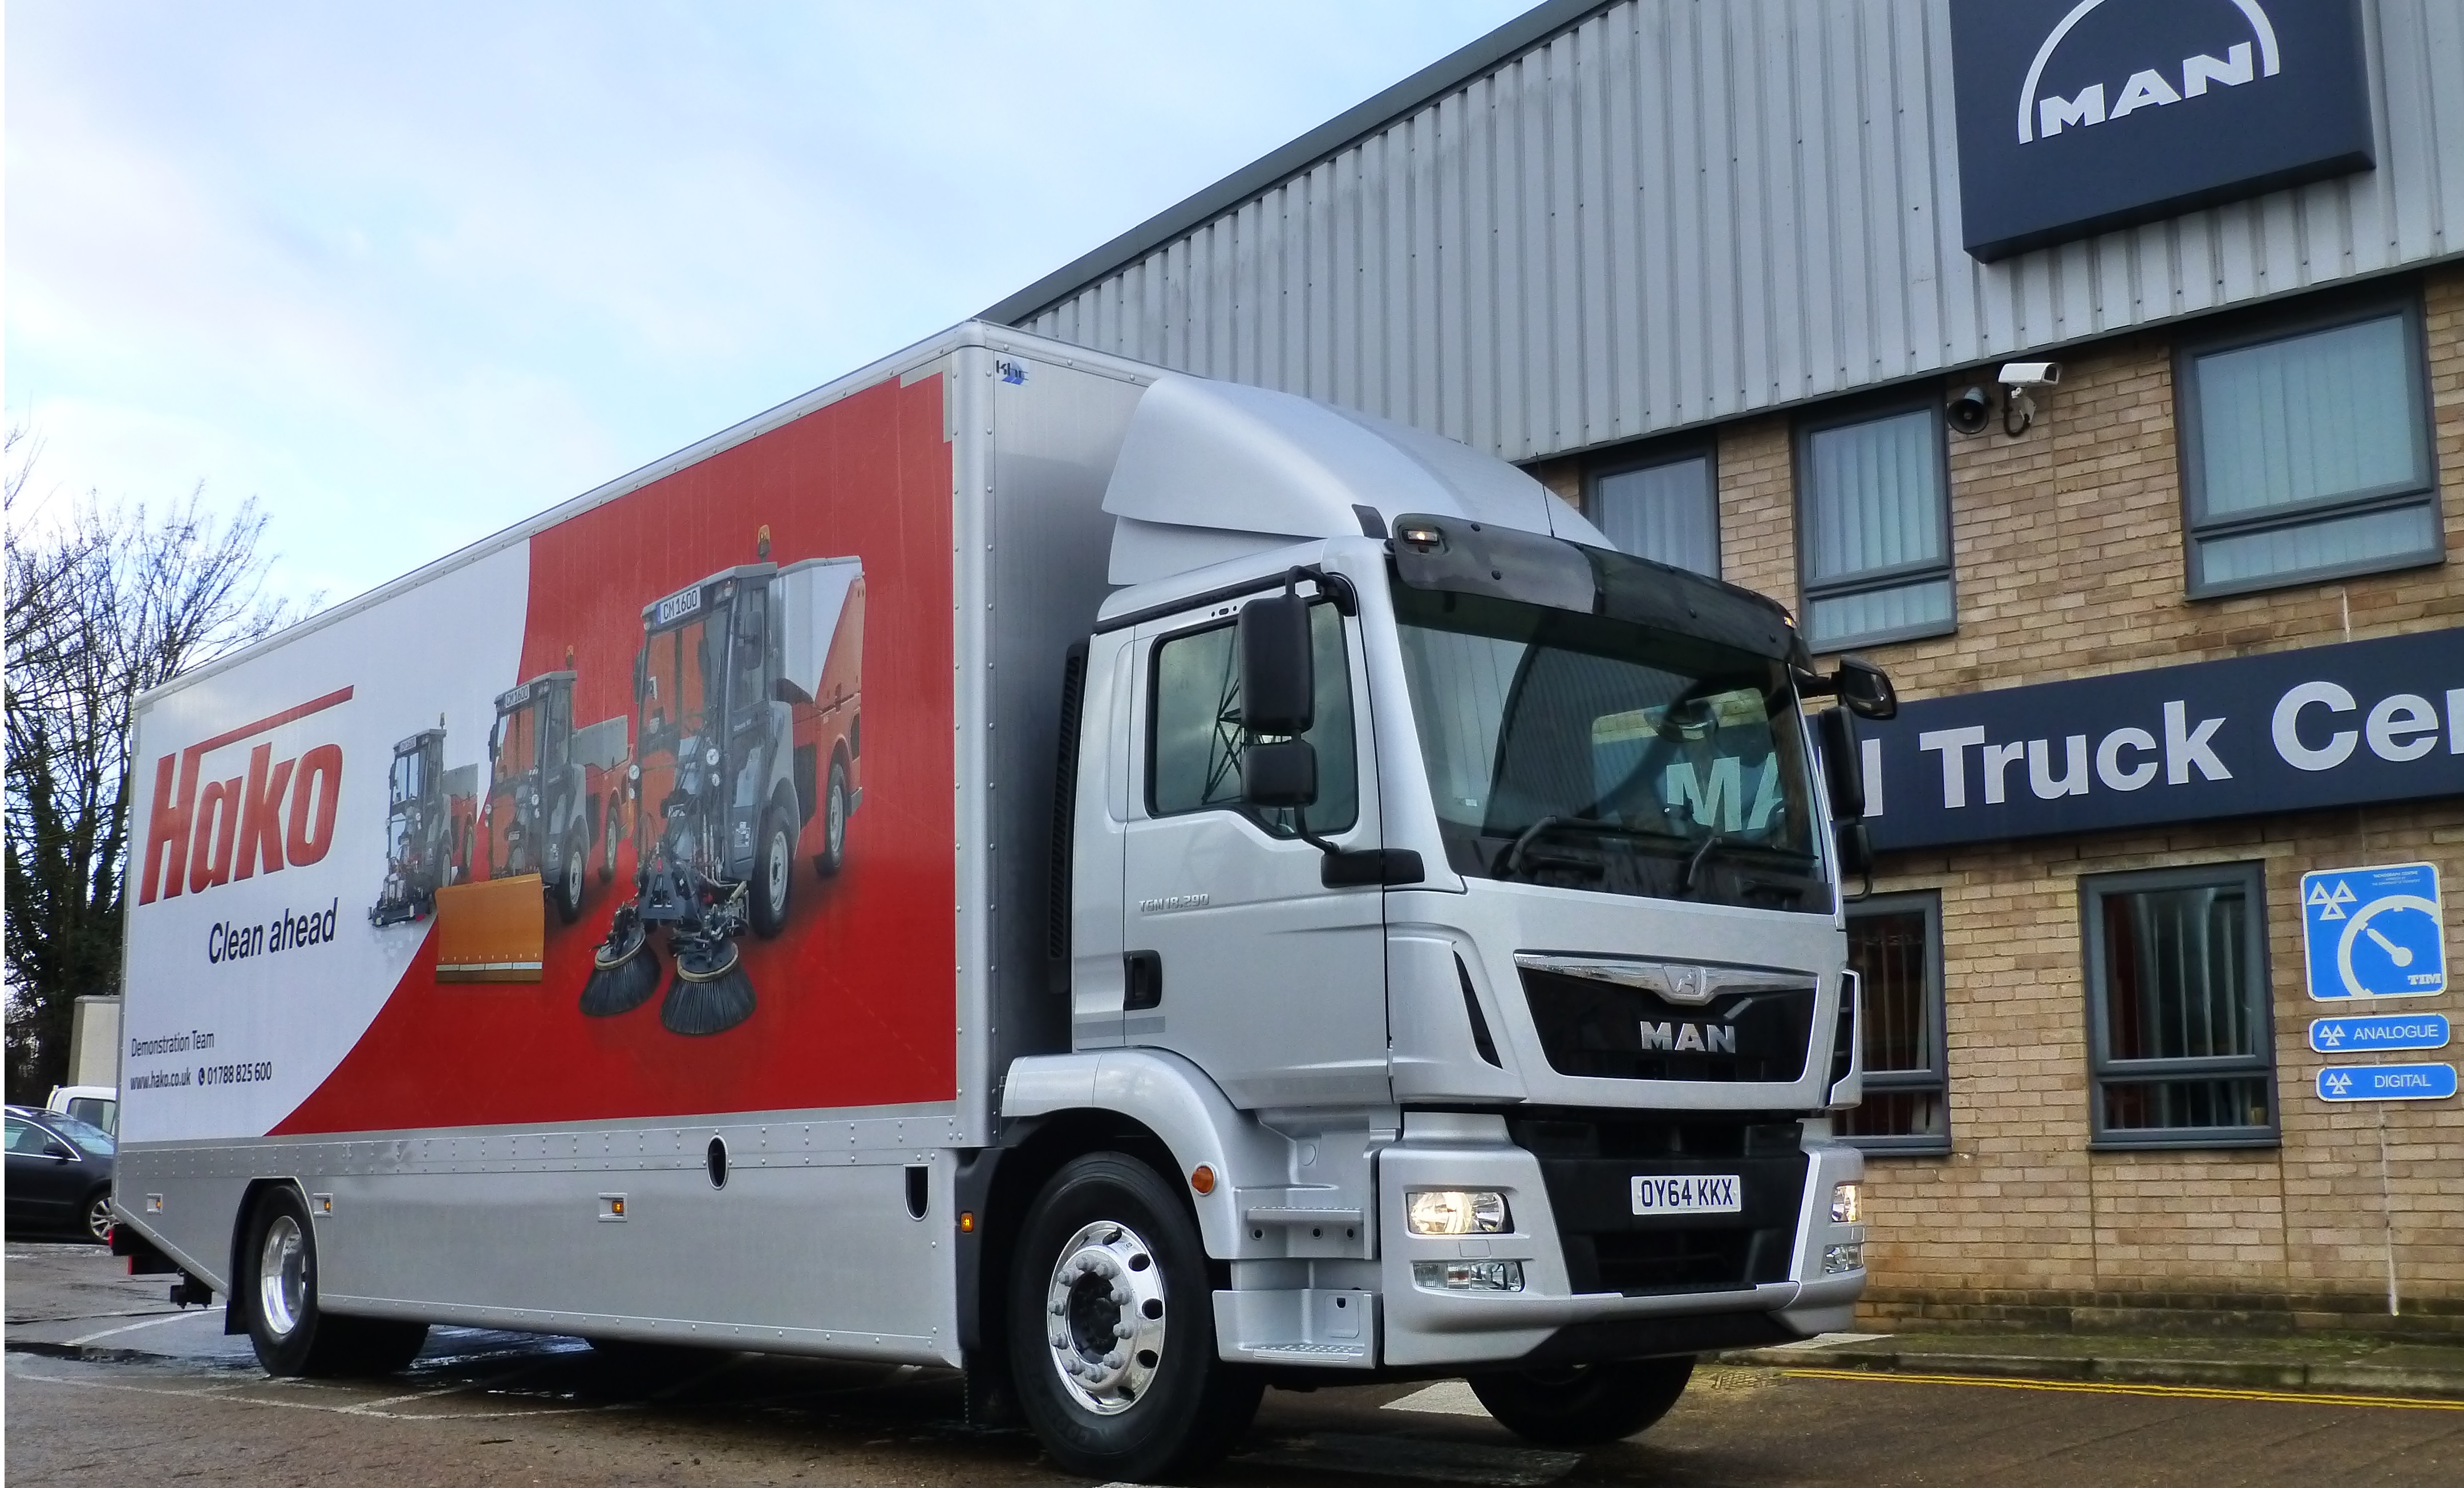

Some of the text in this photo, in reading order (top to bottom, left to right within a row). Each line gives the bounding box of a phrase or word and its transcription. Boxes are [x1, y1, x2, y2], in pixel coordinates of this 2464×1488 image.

[2039, 41, 2254, 138] MAN
[663, 590, 697, 620] CM 1600
[1919, 700, 2233, 808] Truck
[139, 685, 354, 906] Hako
[1139, 893, 1210, 912] TGM 18.290
[209, 897, 338, 964] Clean ahead
[2407, 973, 2442, 986] TIM
[131, 1030, 214, 1057] Demonstration Team
[1640, 1021, 1736, 1053] MAN
[2353, 1024, 2439, 1040] ANALOGUE
[130, 1061, 272, 1090] www.hako.co.uk 01788 825 600
[2374, 1074, 2432, 1088] DIGITAL
[1641, 1178, 1733, 1207] OY64 KKX
